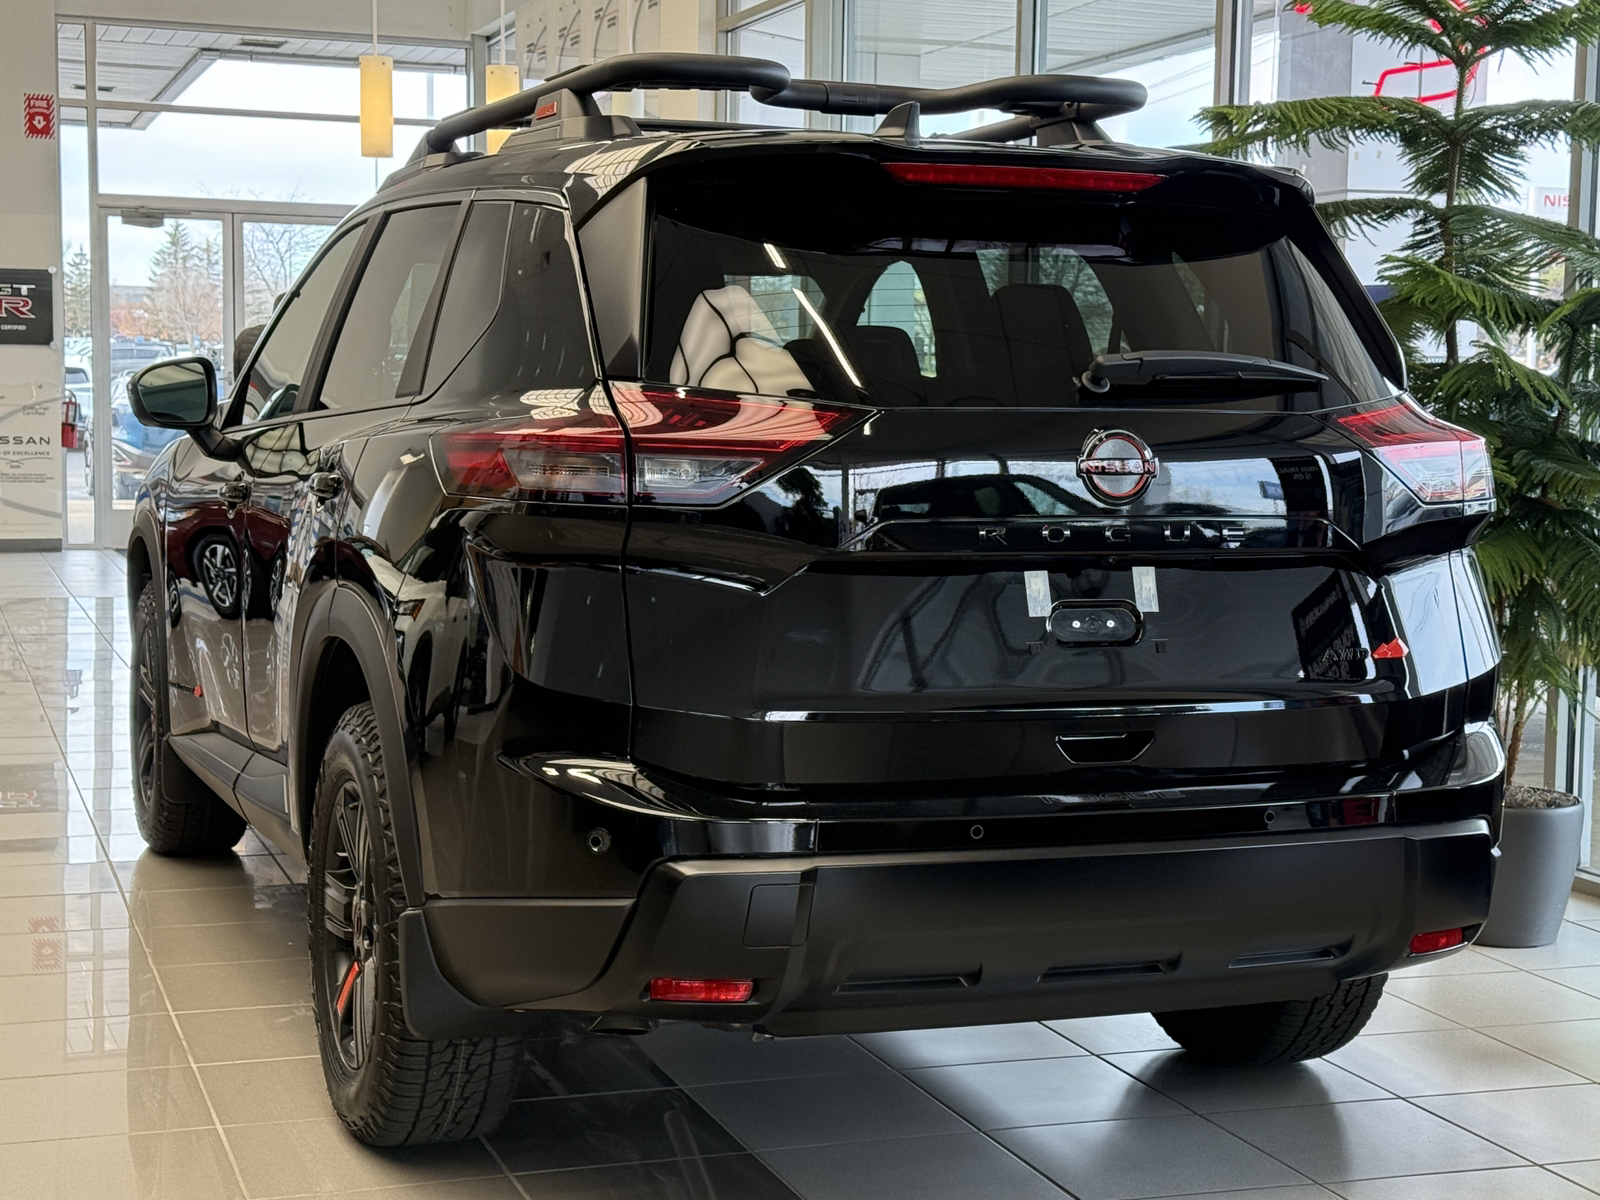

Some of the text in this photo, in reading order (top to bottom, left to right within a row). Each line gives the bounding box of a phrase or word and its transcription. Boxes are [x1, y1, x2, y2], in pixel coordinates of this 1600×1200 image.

[30, 100, 48, 108] FIRE
[1081, 460, 1156, 474] NISSAN
[978, 524, 1246, 547] ROGUE
